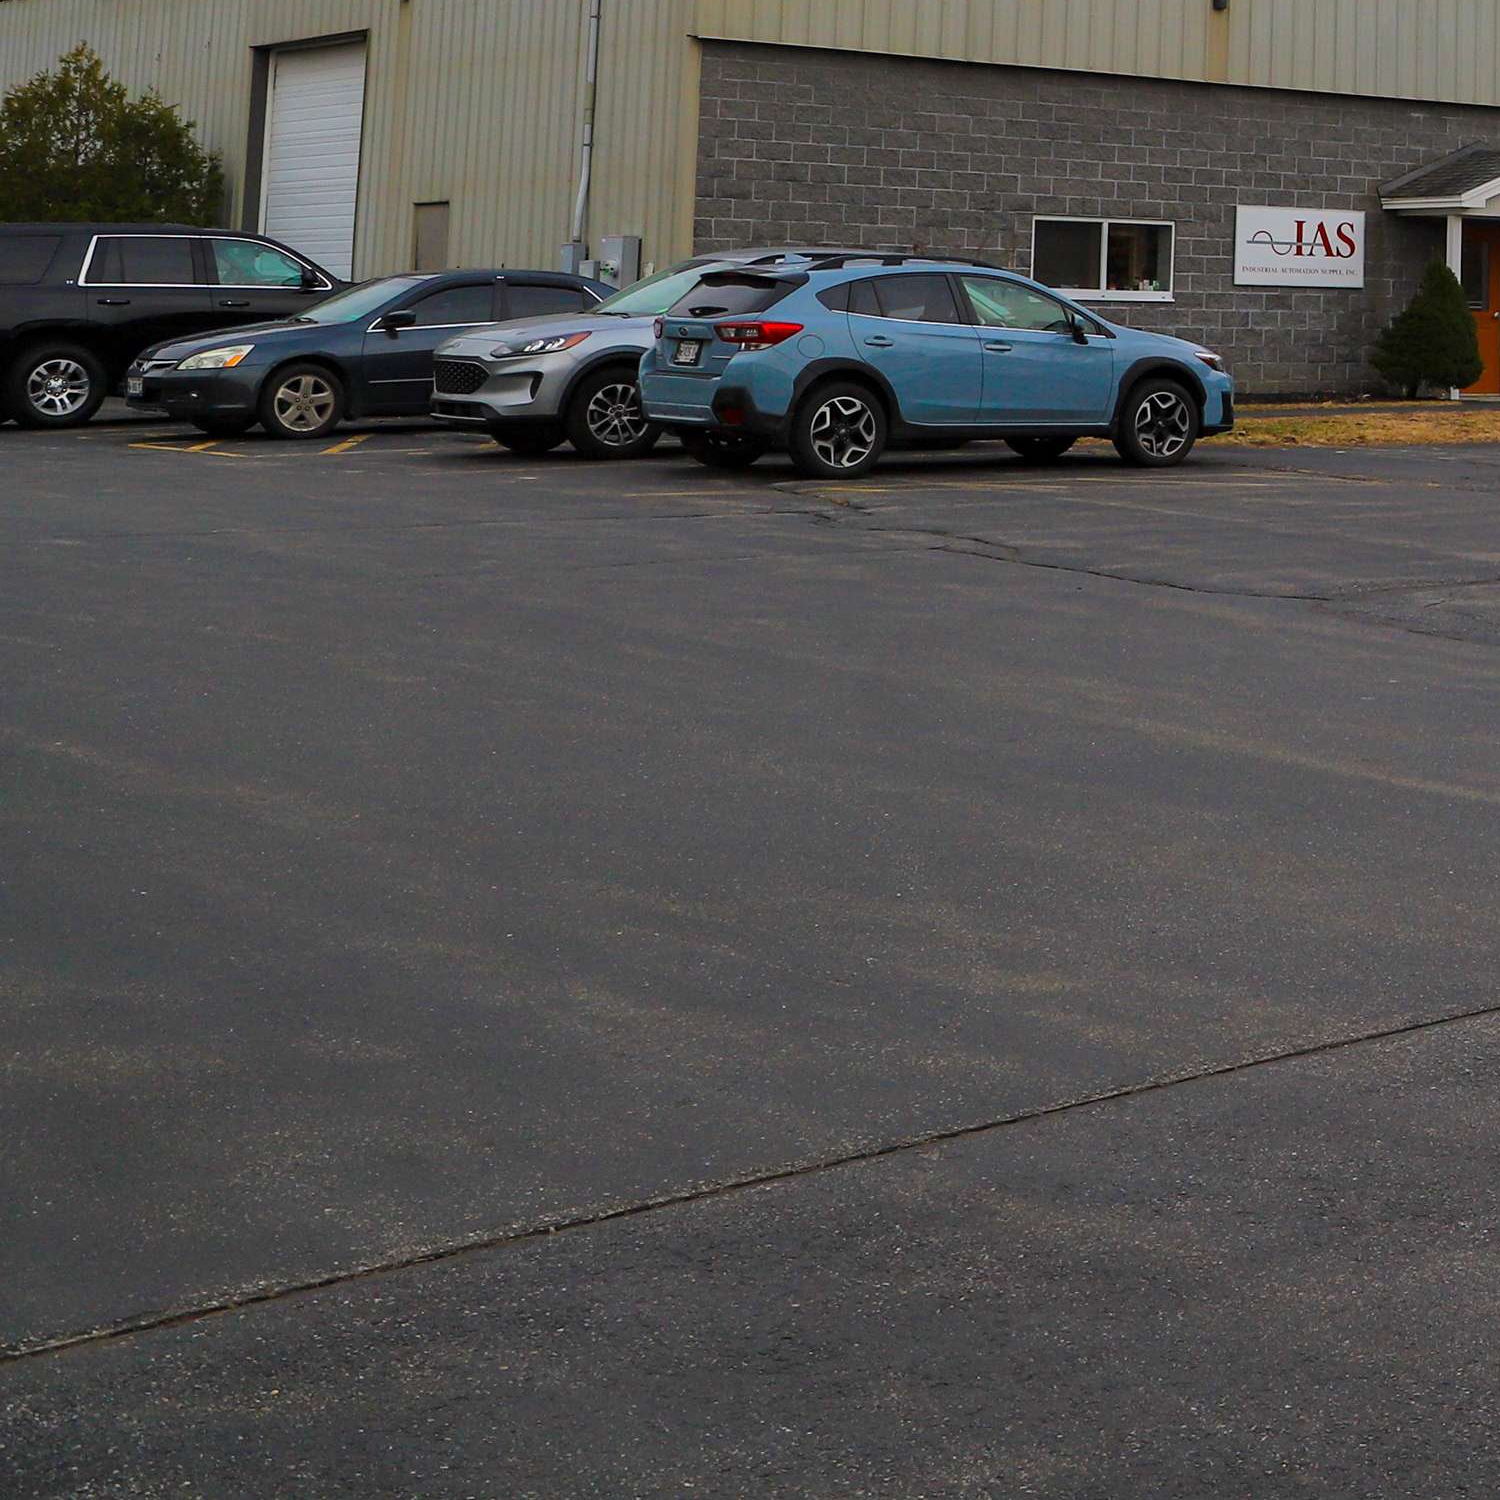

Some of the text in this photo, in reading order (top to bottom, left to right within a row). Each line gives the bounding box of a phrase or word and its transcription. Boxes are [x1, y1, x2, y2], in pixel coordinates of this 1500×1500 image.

[1293, 219, 1357, 259] IAS
[1242, 265, 1278, 273] INDUSTRIAL
[1281, 266, 1319, 275] AUTOMATION
